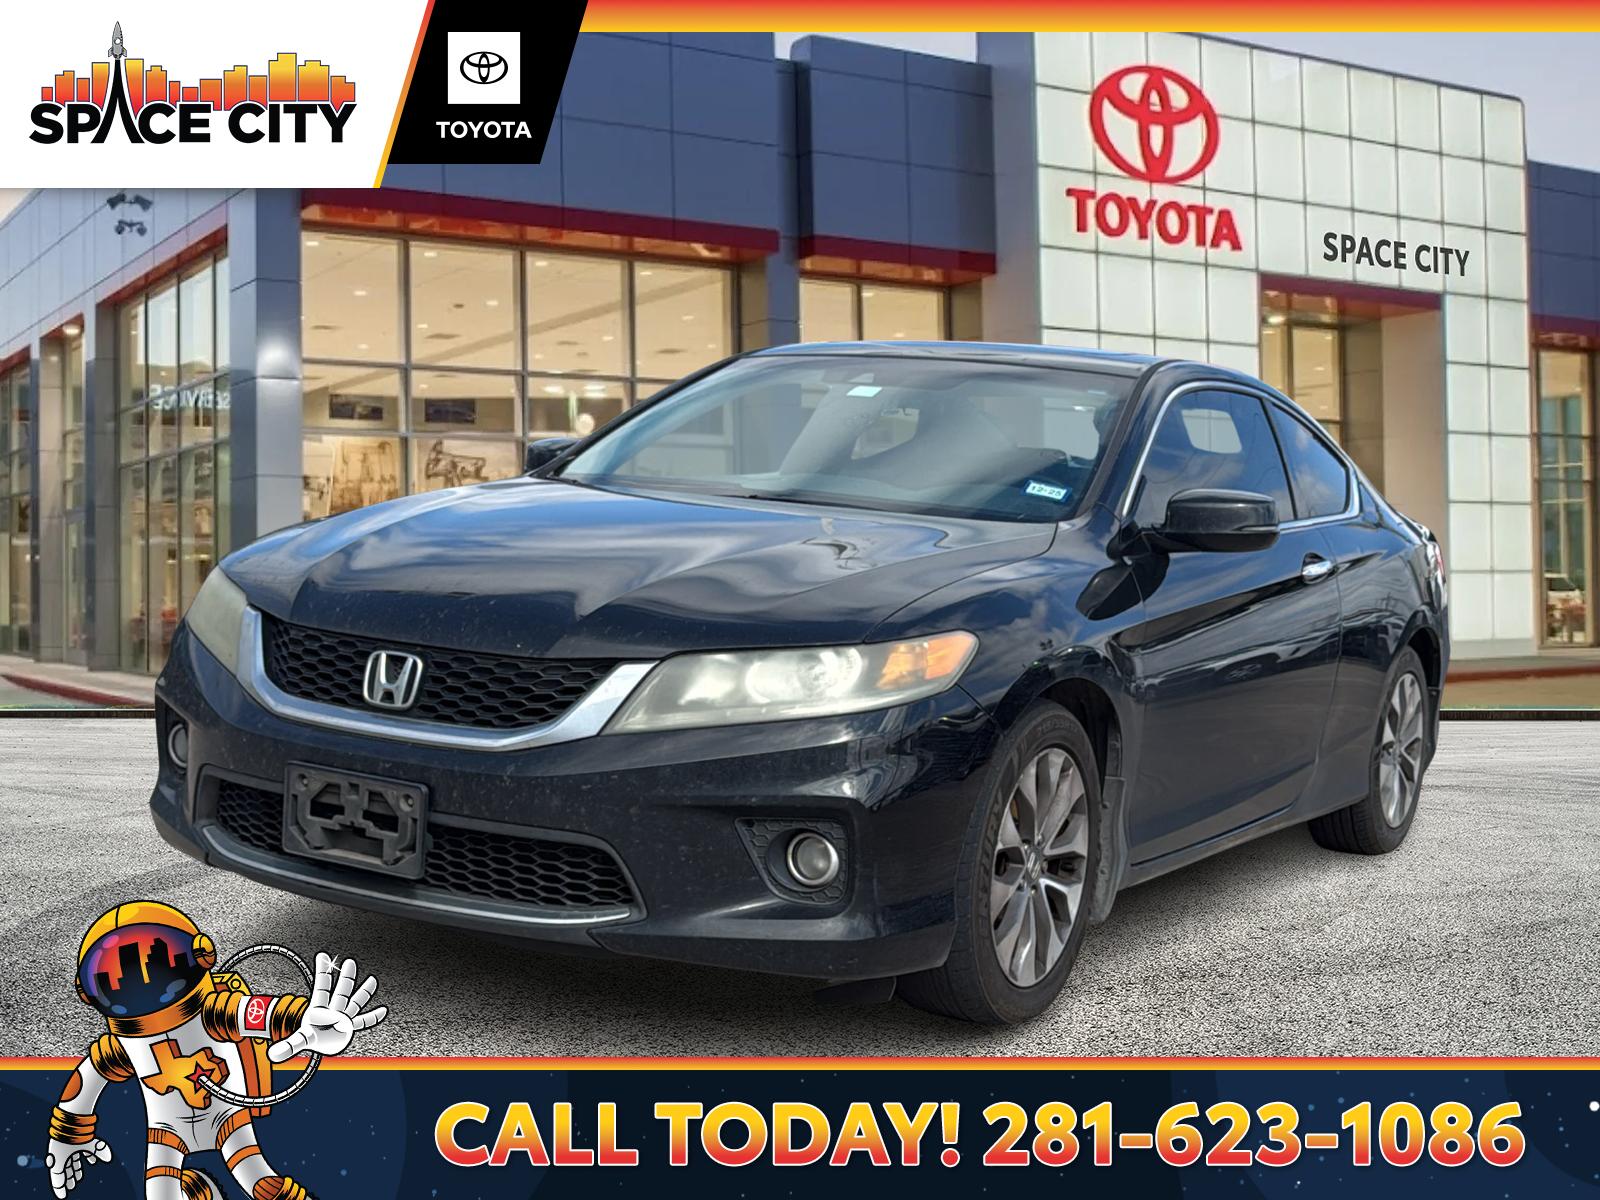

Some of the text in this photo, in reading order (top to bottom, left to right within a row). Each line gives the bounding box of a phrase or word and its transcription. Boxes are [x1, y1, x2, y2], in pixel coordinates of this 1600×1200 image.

[1066, 187, 1243, 252] TOYOTA
[1323, 231, 1470, 277] SPACE CITY
